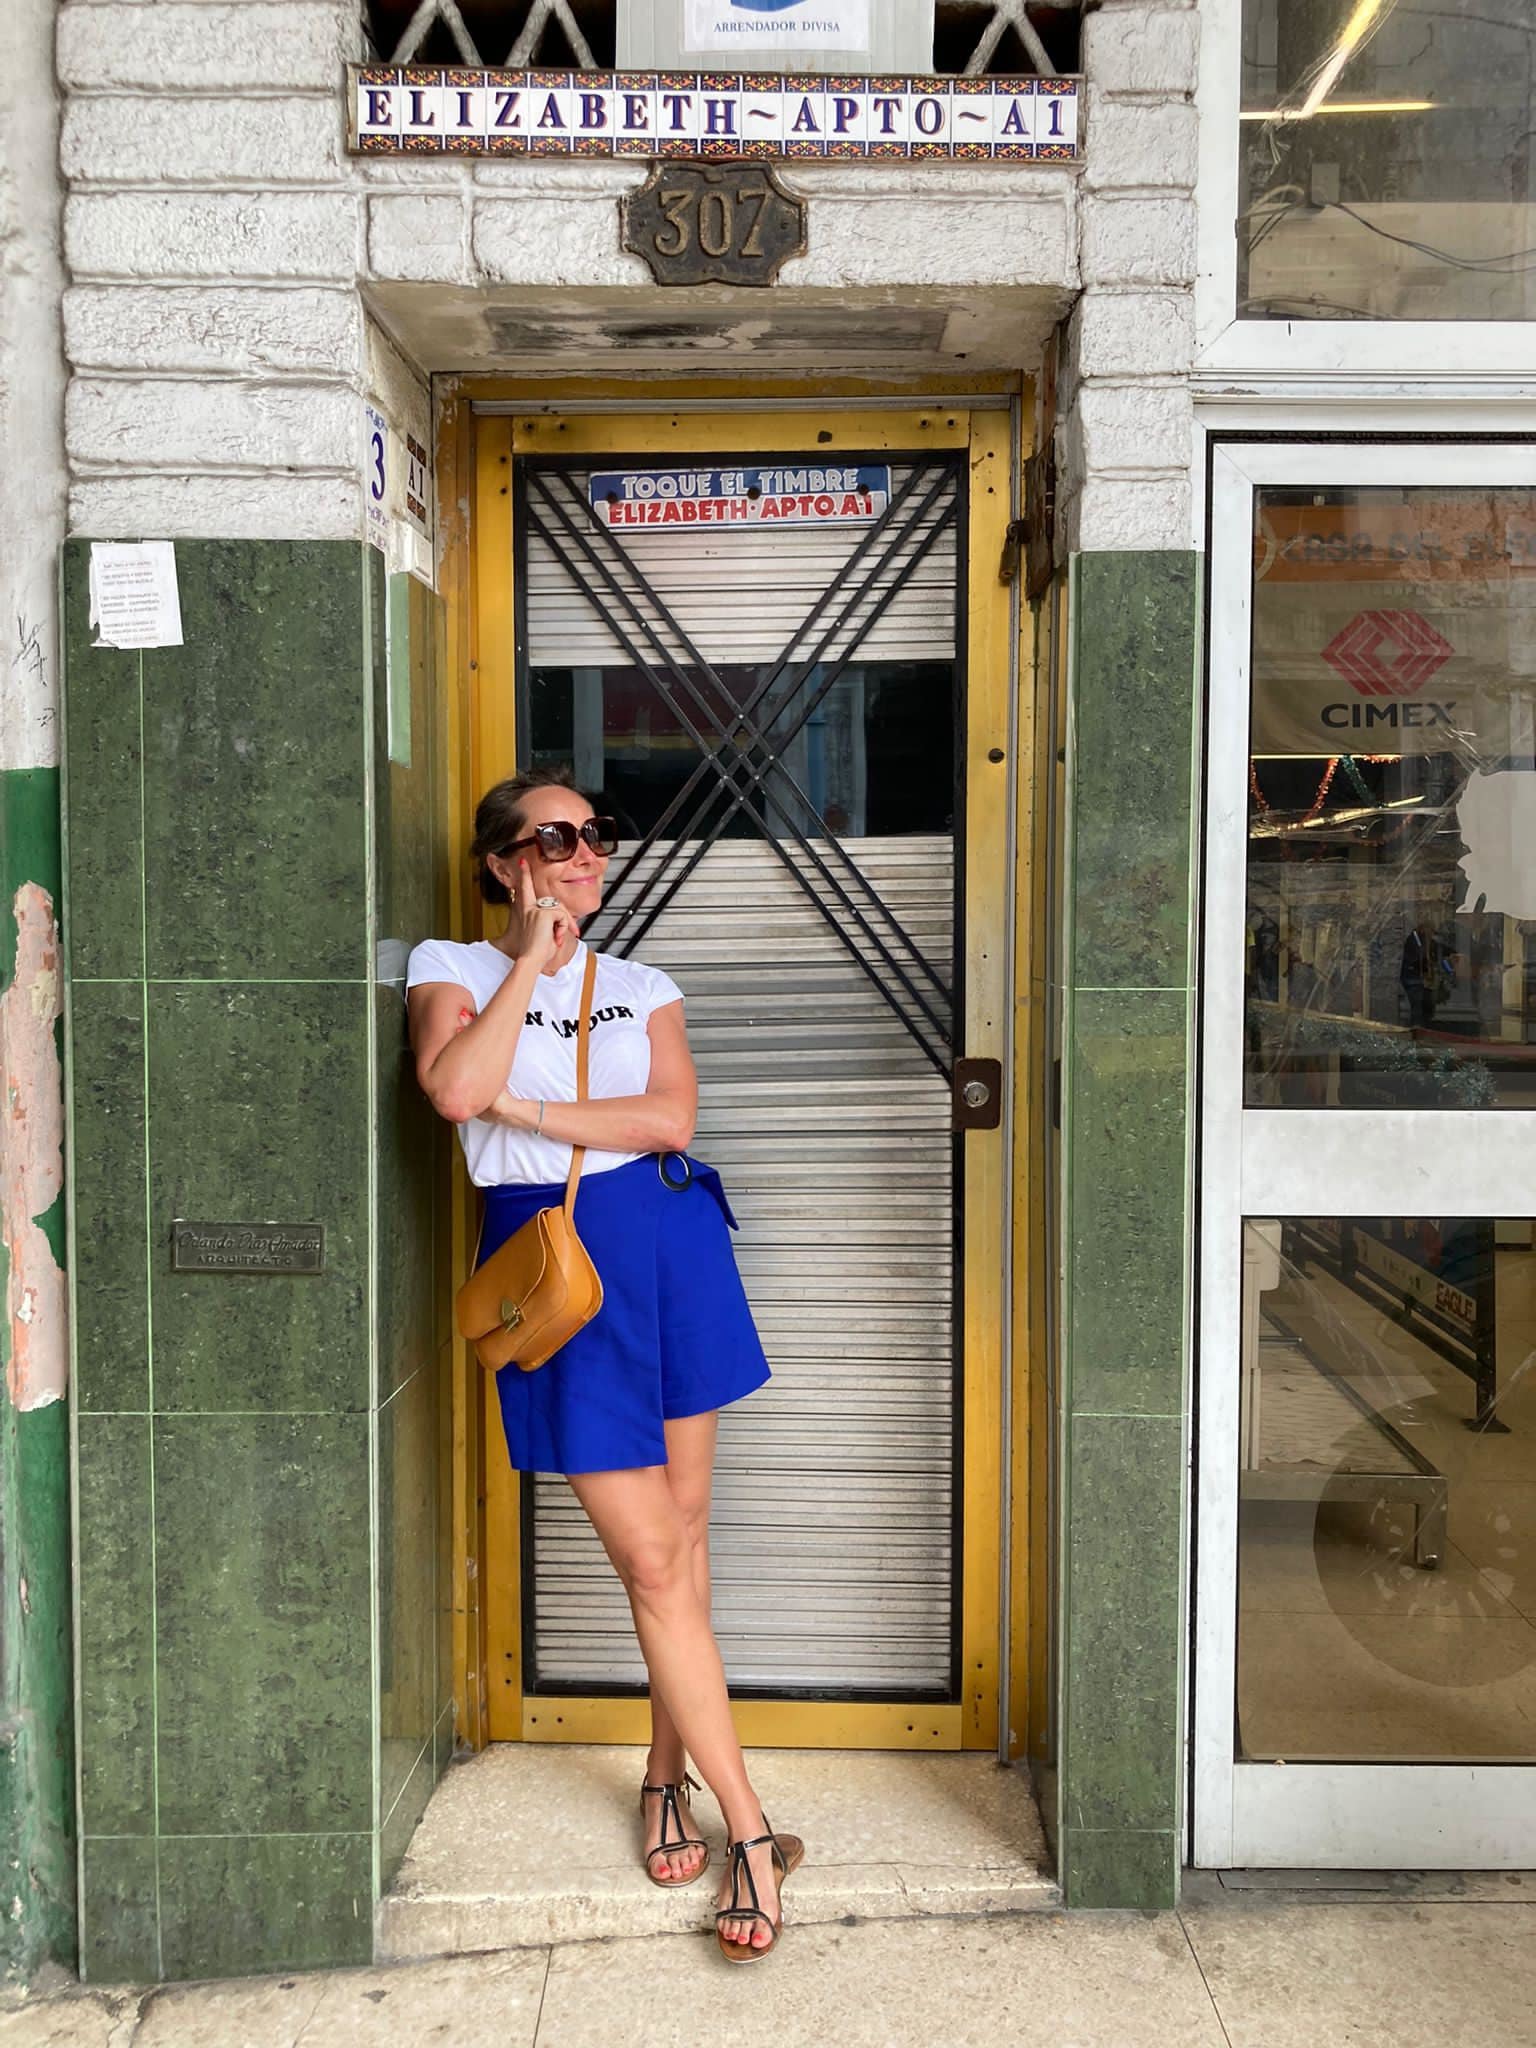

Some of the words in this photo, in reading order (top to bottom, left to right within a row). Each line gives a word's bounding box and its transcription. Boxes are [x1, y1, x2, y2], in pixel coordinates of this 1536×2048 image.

[713, 20, 797, 32] ARRENDADOR
[802, 20, 841, 32] DIVISA
[654, 189, 771, 258] 307
[371, 431, 386, 501] 3
[622, 473, 712, 499] TOQUE
[720, 470, 750, 494] EL
[758, 467, 859, 494] TIMBRE
[608, 499, 748, 525] ELIZABETH
[1320, 702, 1457, 728] CIMEX
[1435, 1281, 1474, 1322] EAGLE
